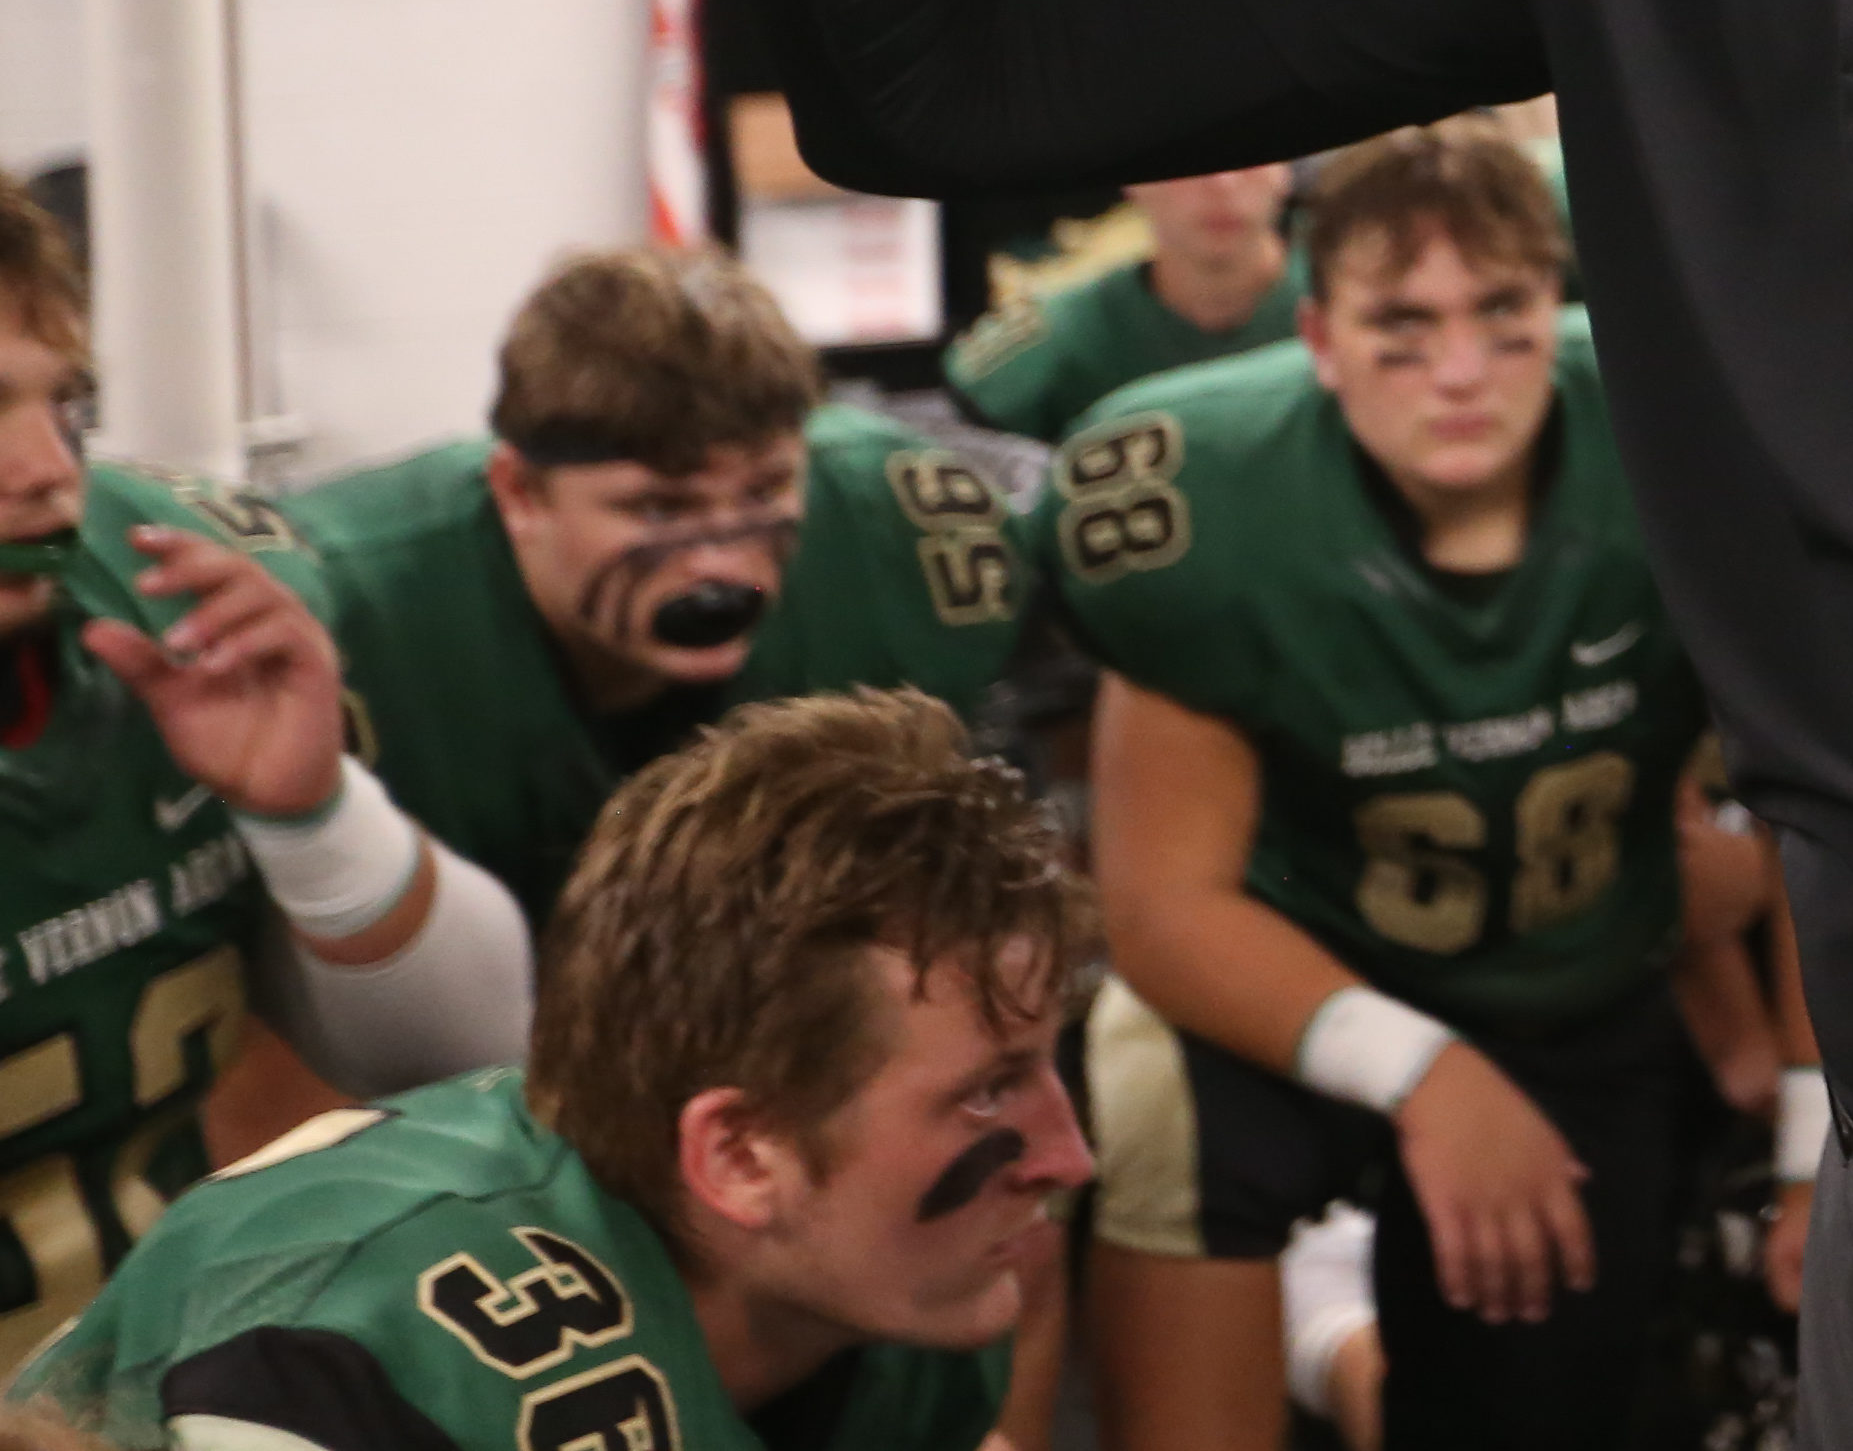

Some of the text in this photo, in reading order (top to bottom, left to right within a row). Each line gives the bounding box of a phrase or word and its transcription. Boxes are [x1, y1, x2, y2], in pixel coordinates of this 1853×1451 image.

[885, 449, 1014, 626] 95
[1053, 411, 1192, 584] 68
[1354, 751, 1636, 954] 68
